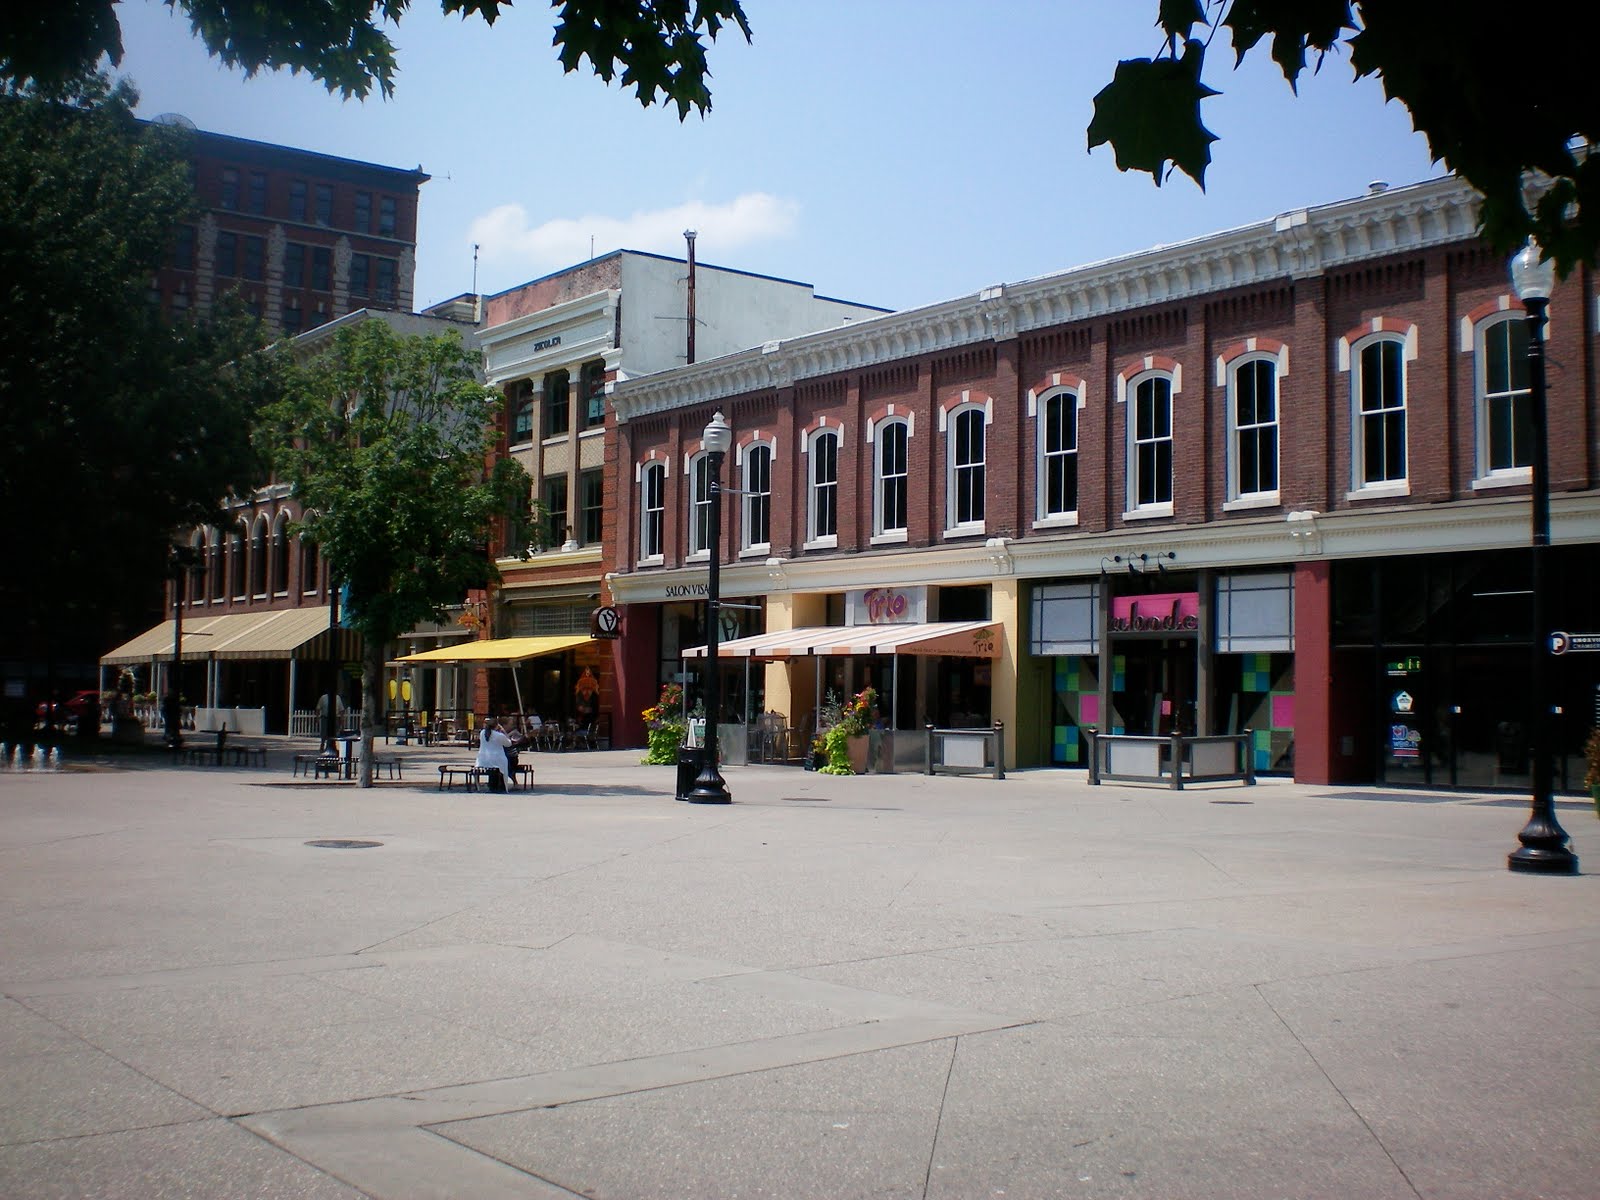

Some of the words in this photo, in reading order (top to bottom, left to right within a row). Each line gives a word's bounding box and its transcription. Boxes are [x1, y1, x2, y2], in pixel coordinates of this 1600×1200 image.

[666, 584, 691, 597] SALON
[863, 588, 908, 623] Trio
[1109, 598, 1199, 631] abode
[973, 640, 994, 655] Trio
